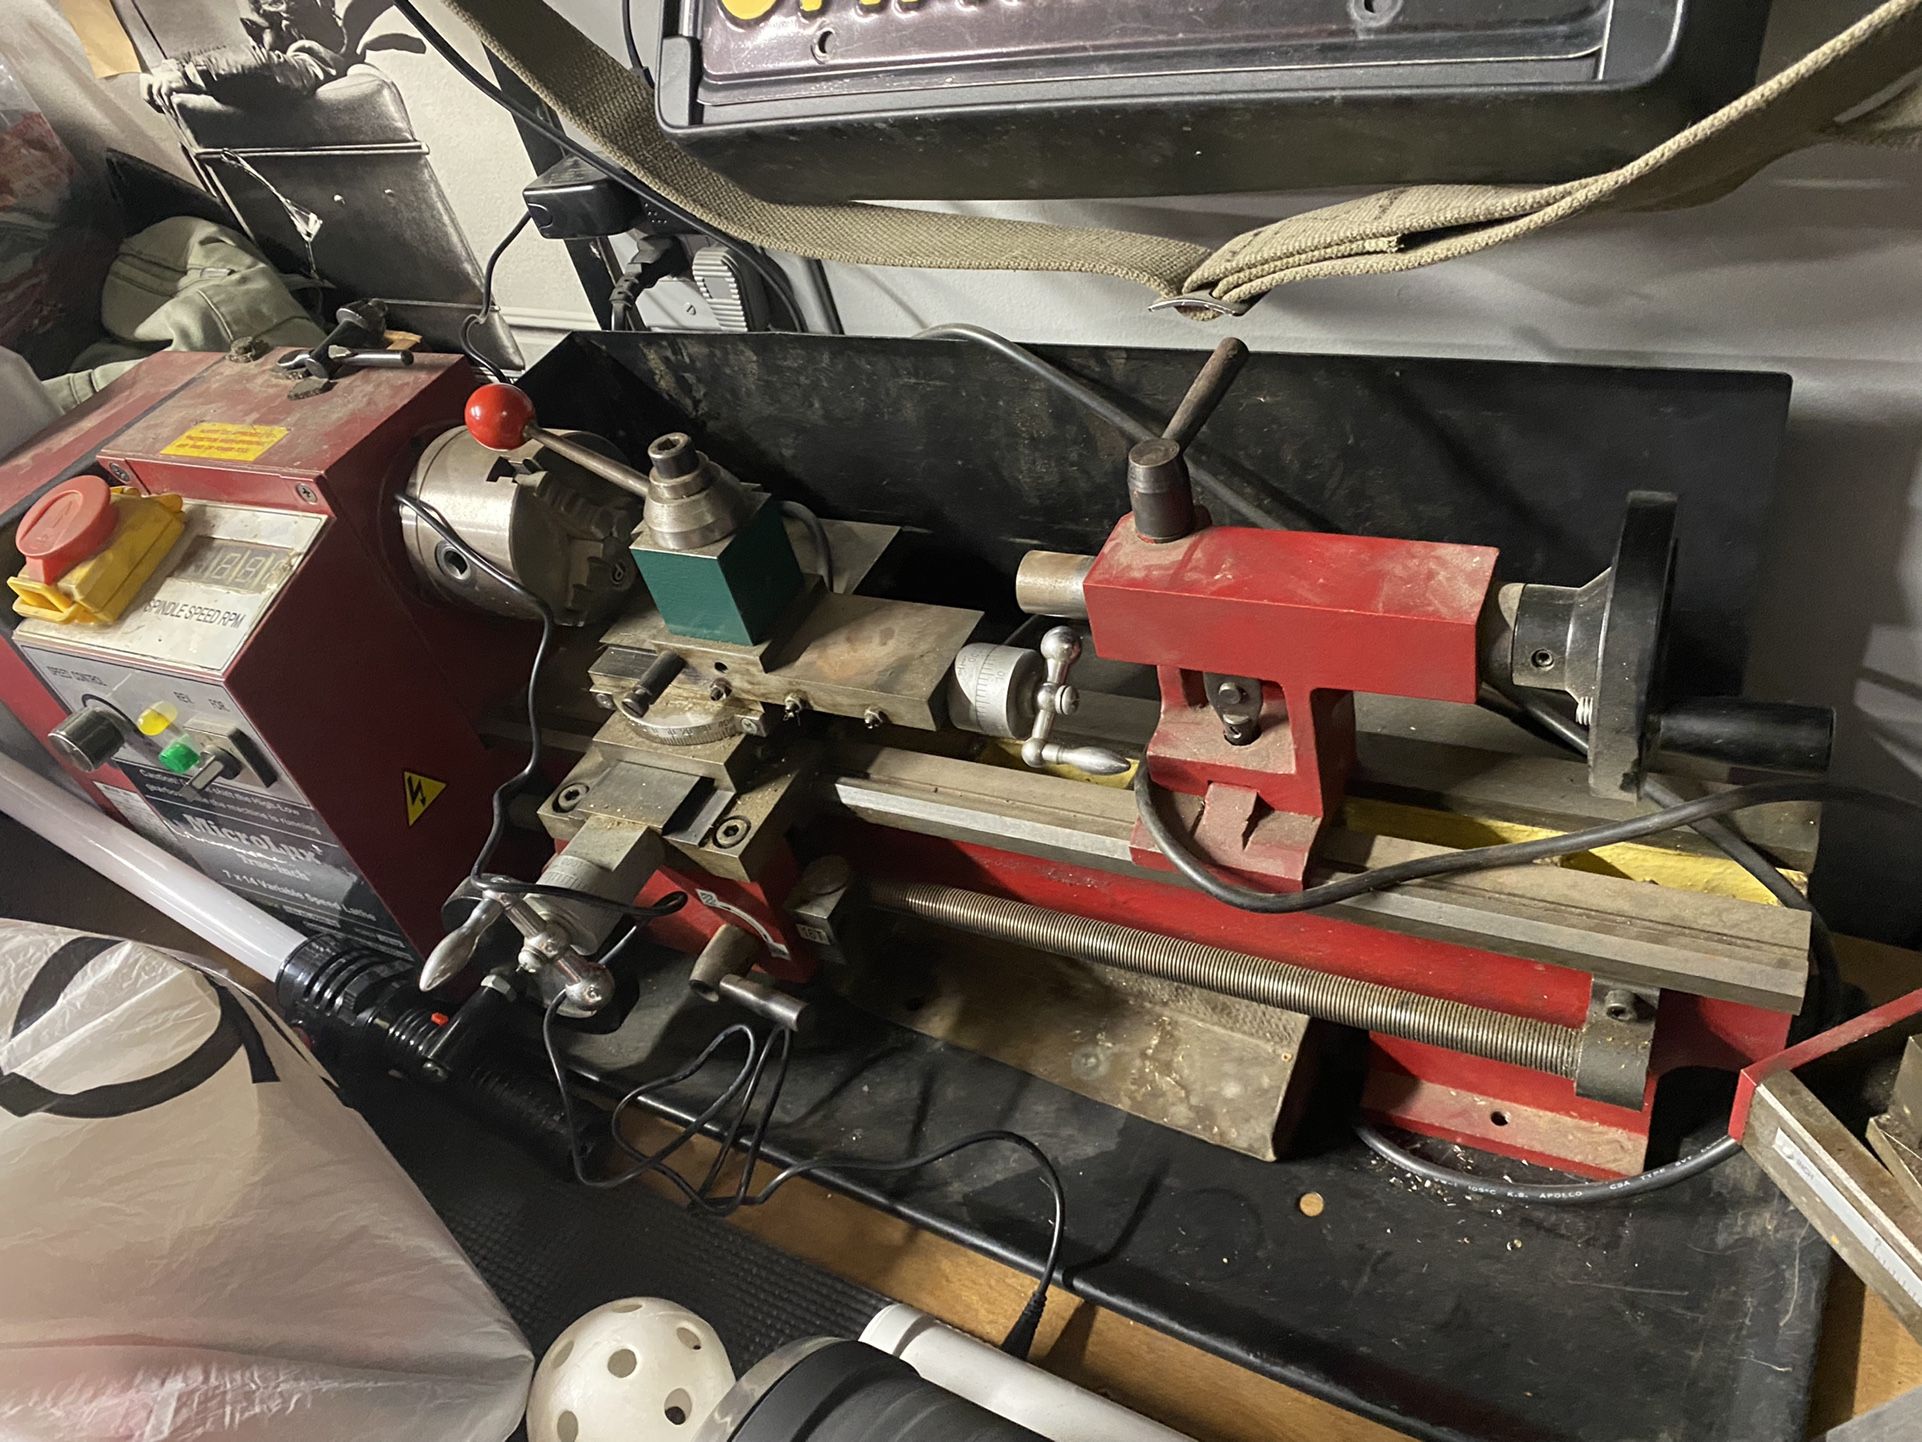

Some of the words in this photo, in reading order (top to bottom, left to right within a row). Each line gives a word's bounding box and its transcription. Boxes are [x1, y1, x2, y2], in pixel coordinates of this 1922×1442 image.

[143, 599, 188, 619] SPINDLE
[184, 605, 222, 624] SPEED
[218, 611, 246, 629] RPM
[242, 875, 259, 887] 14
[257, 879, 305, 899] Variable
[304, 893, 342, 911] Speed
[341, 904, 376, 922] Lathe
[1540, 1190, 1583, 1199] APOLLO
